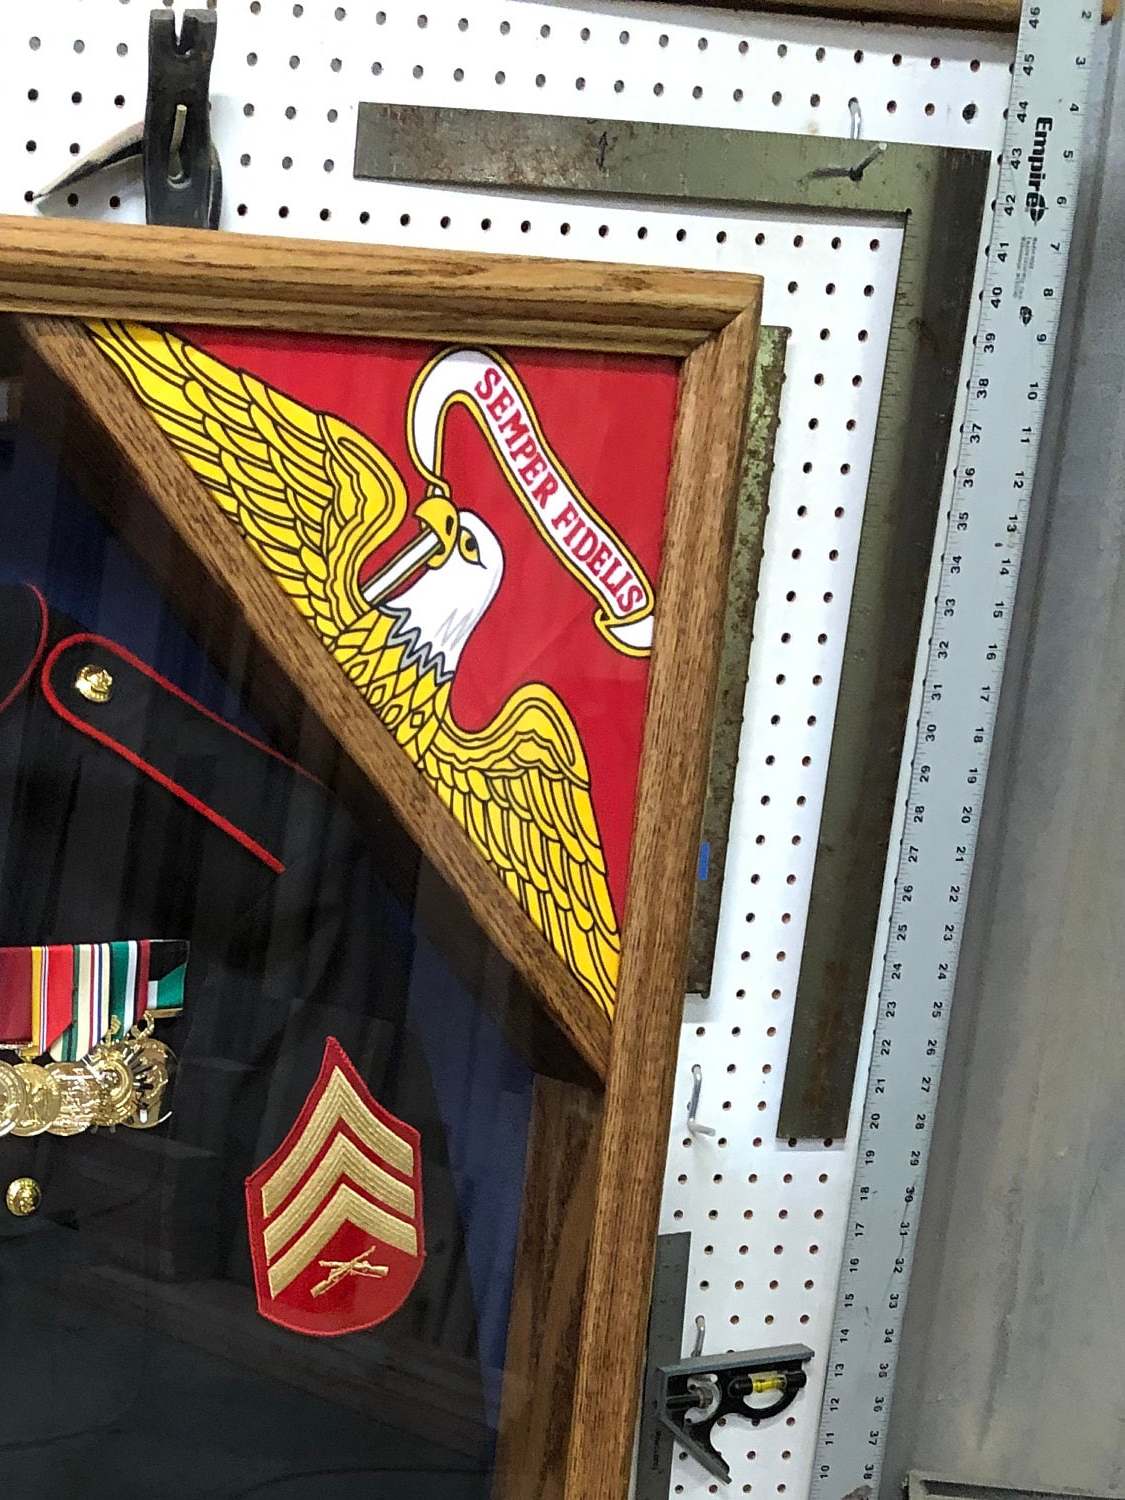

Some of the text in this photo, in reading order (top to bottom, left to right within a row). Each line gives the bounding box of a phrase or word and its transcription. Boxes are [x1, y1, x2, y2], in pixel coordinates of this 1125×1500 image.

[1029, 6, 1040, 29] 46
[1081, 10, 1092, 20] 2
[1023, 54, 1034, 76] 45
[1075, 57, 1086, 66] 3
[1017, 101, 1028, 123] 44
[1069, 103, 1080, 113] 4
[1011, 148, 1022, 170] 43
[1026, 117, 1053, 207] Empire
[1063, 150, 1074, 159] 5
[1004, 194, 1016, 216] 42
[1056, 196, 1067, 205] 6
[997, 242, 1009, 263] 41
[1050, 242, 1061, 251] 7
[991, 287, 1003, 309] 40
[1043, 288, 1054, 297] 8
[984, 333, 996, 354] 39
[1036, 333, 1047, 342] 9
[977, 378, 989, 399] 38
[1027, 381, 1039, 400] 10
[970, 423, 982, 444] 37
[1020, 426, 1032, 444] 11
[963, 467, 976, 488] 36
[1013, 470, 1025, 489] 12
[475, 367, 644, 613] SEMPER FIDELIS
[957, 511, 969, 531] 35
[1007, 514, 1018, 533] 13
[950, 555, 962, 574] 34
[999, 558, 1012, 576] 14
[944, 598, 956, 617] 33
[993, 600, 1005, 619] 15
[938, 640, 949, 659] 32
[986, 643, 998, 661] 16
[931, 684, 943, 701] 31
[980, 685, 991, 702] 17
[925, 724, 937, 742] 30
[973, 726, 985, 744] 18
[919, 765, 931, 783] 29
[967, 767, 978, 784] 19
[914, 805, 925, 823] 28
[961, 806, 973, 824] 20
[908, 845, 919, 863] 27
[955, 846, 966, 862] 21
[902, 885, 914, 903] 26
[949, 885, 961, 903] 22
[896, 924, 908, 941] 25
[943, 924, 955, 942] 23
[891, 962, 902, 980] 24
[937, 963, 949, 980] 24
[886, 1001, 897, 1018] 23
[932, 1001, 943, 1019] 25
[880, 1039, 892, 1056] 22
[926, 1039, 938, 1057] 26
[875, 1078, 886, 1094] 21
[921, 1076, 931, 1093] 27
[870, 1112, 881, 1130] 20
[915, 1114, 926, 1131] 28
[865, 1150, 875, 1165] 19
[909, 1150, 921, 1166] 29
[860, 1186, 870, 1201] 18
[904, 1186, 915, 1203] 30
[854, 1222, 865, 1237] 17
[899, 1221, 910, 1237] 31
[849, 1258, 860, 1273] 16
[893, 1257, 905, 1274] 32
[844, 1293, 855, 1308] 15
[888, 1293, 900, 1309] 33
[839, 1328, 850, 1343] 14
[884, 1328, 894, 1344] 34
[835, 1363, 845, 1377] 13
[878, 1362, 889, 1378] 35
[830, 1397, 840, 1412] 12
[873, 1396, 884, 1413] 36
[825, 1432, 835, 1446] 11
[869, 1430, 880, 1446] 37
[820, 1465, 830, 1480] 10
[863, 1464, 875, 1480] 38
